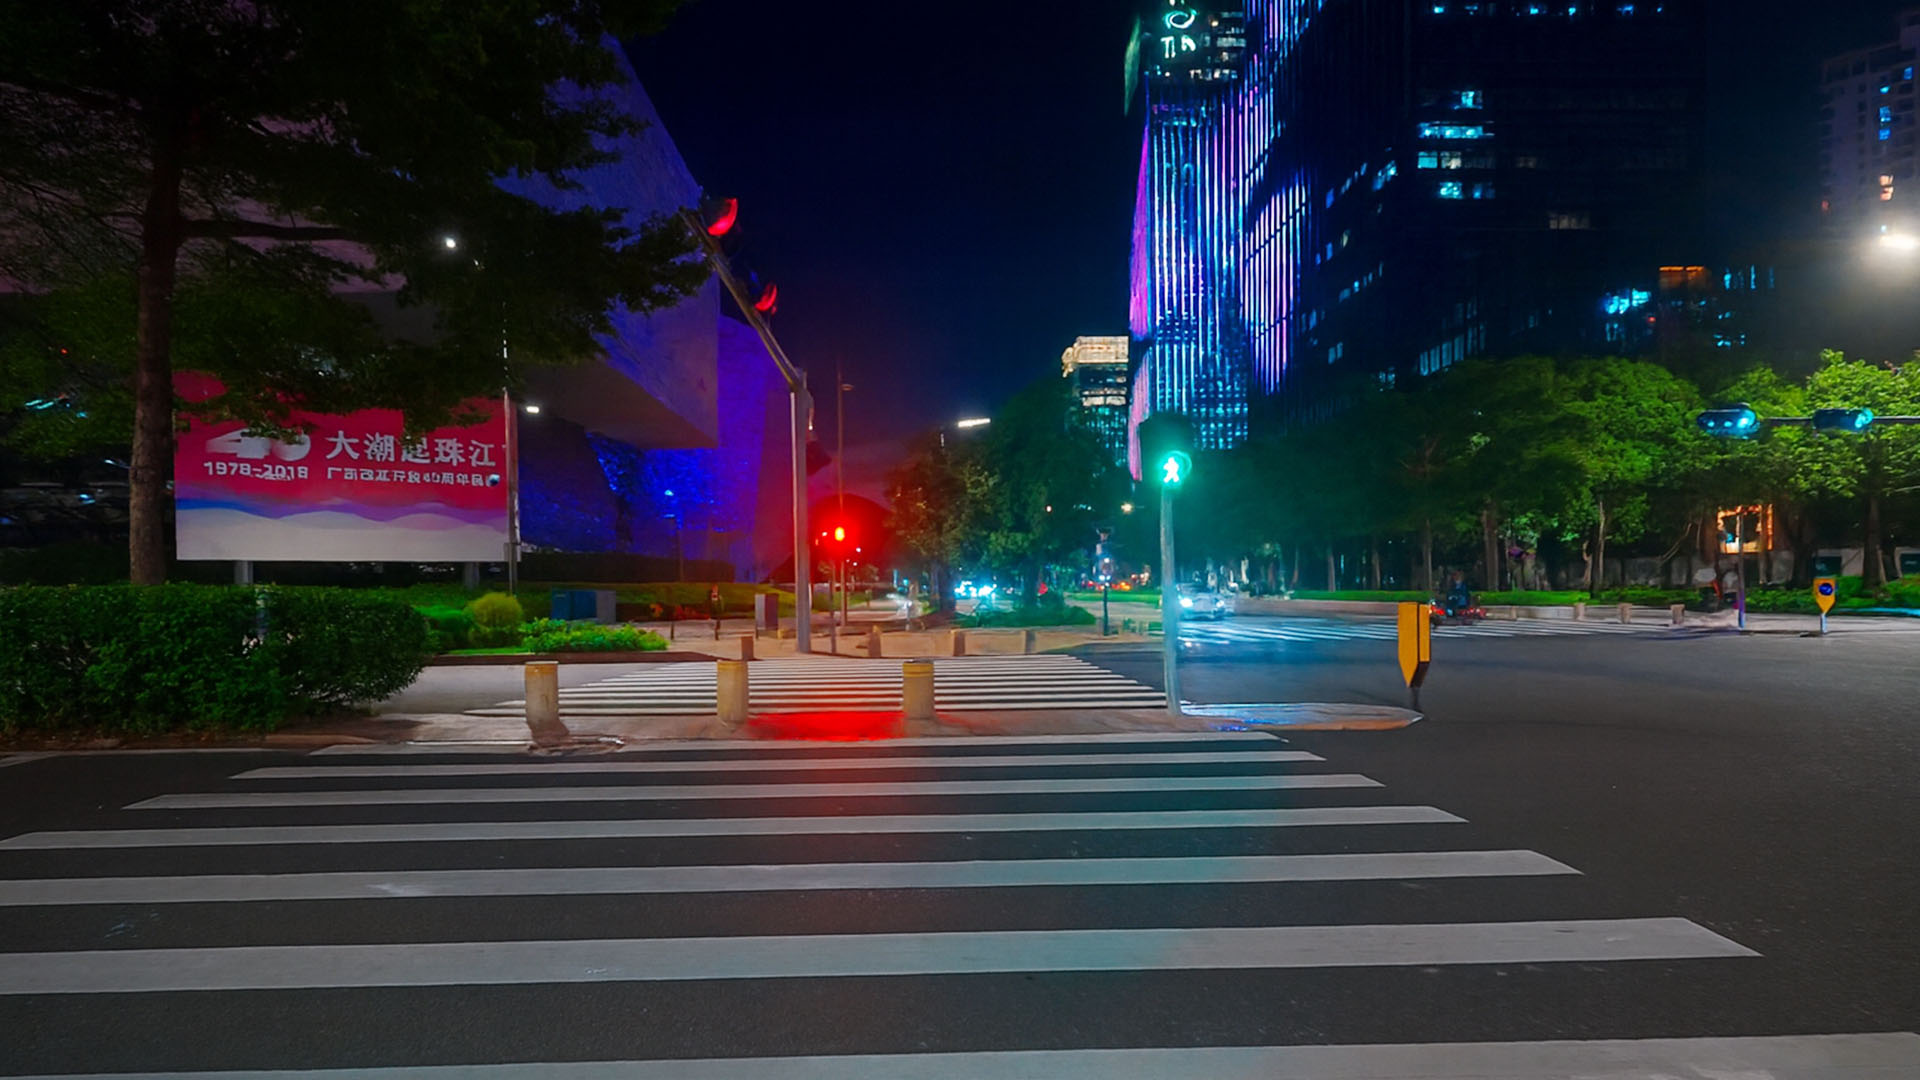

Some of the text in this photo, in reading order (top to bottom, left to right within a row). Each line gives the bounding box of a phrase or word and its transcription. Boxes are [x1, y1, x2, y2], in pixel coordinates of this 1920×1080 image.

[325, 430, 496, 466] 大潮起珠江
